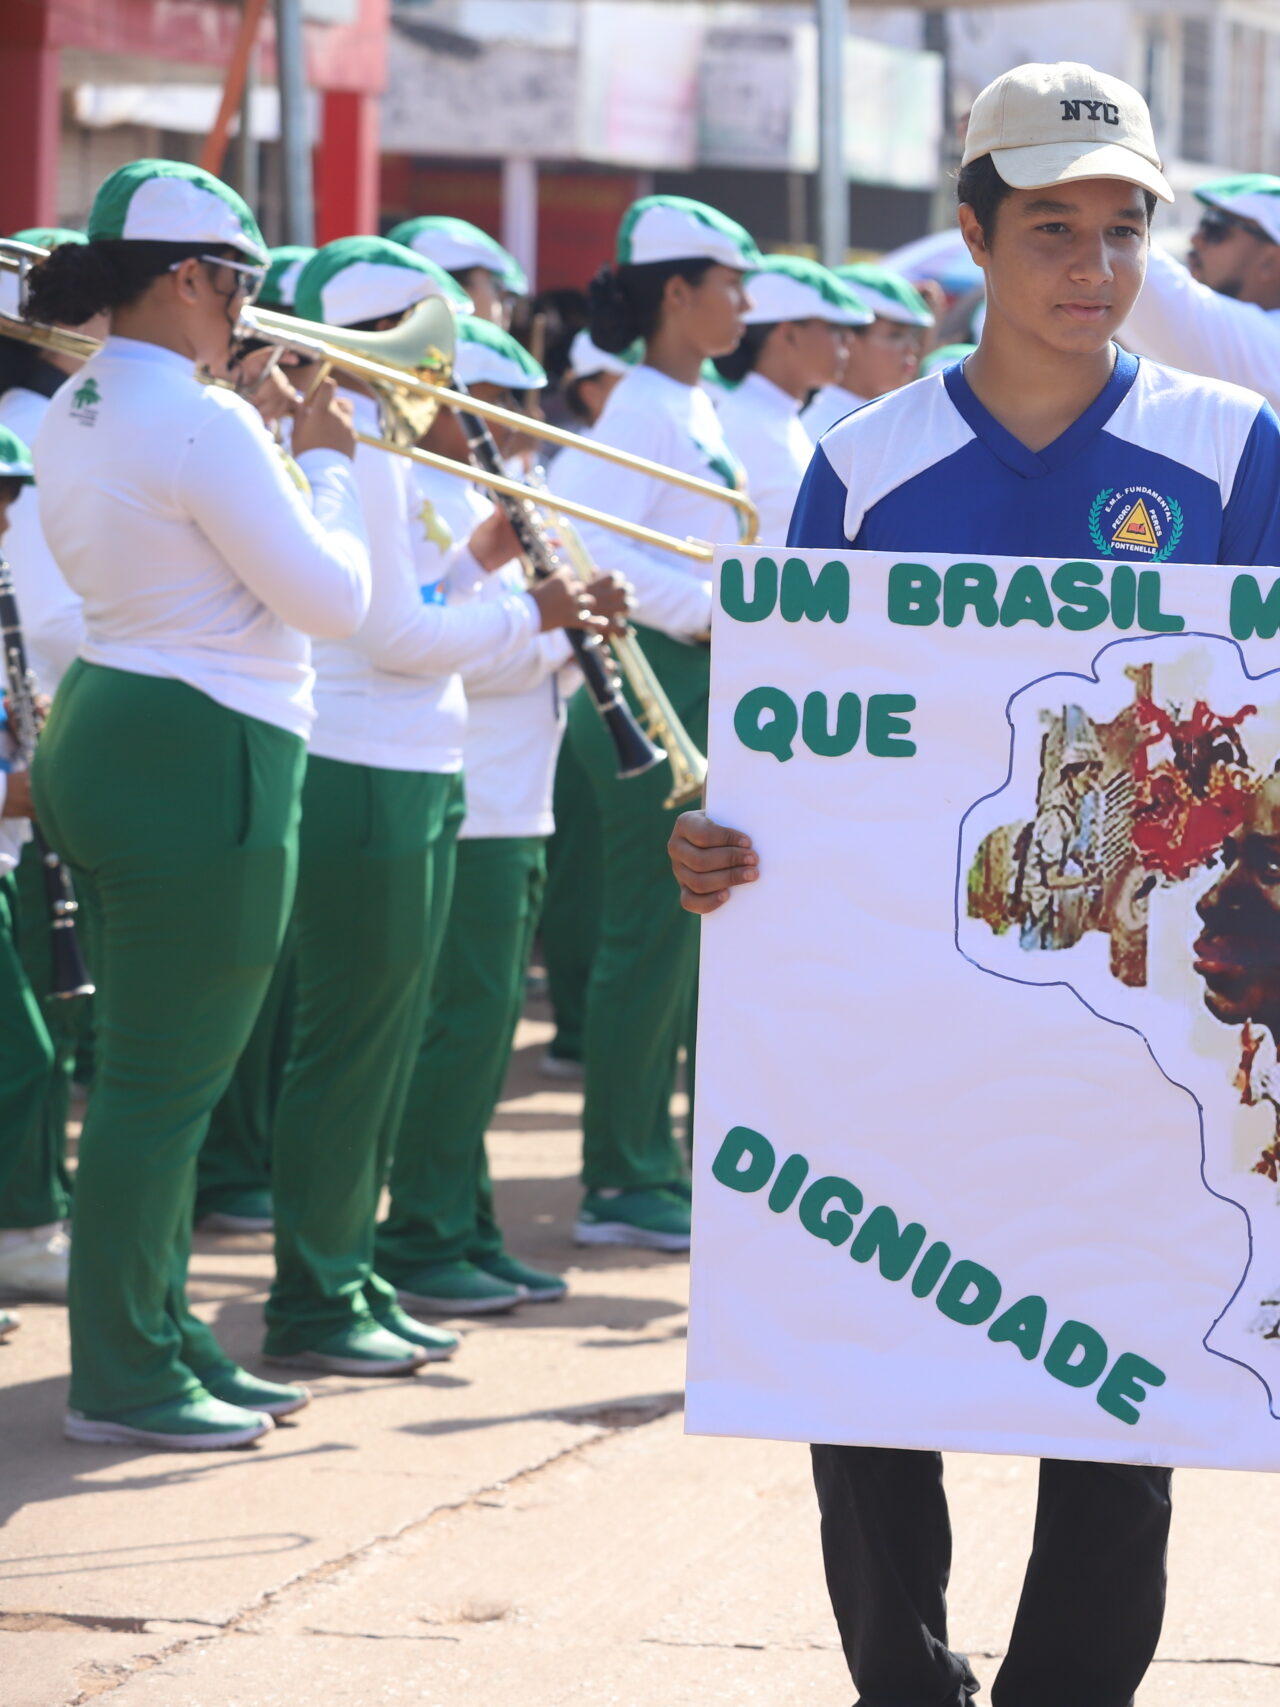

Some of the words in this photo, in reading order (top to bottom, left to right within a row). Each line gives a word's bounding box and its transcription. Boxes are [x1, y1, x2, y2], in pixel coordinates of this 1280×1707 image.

[1060, 99, 1119, 125] NYC
[1104, 492, 1124, 513] E.M.E.
[1124, 486, 1173, 523] FUNDAMENTAL
[1111, 504, 1131, 530] PEDRO
[1149, 508, 1163, 537] PERES
[1111, 541, 1157, 555] FONTENELLE
[720, 557, 849, 623] UM
[888, 563, 1184, 632] BRASIL
[733, 686, 917, 762] QUE
[712, 1126, 1166, 1425] DIGNIDADE
